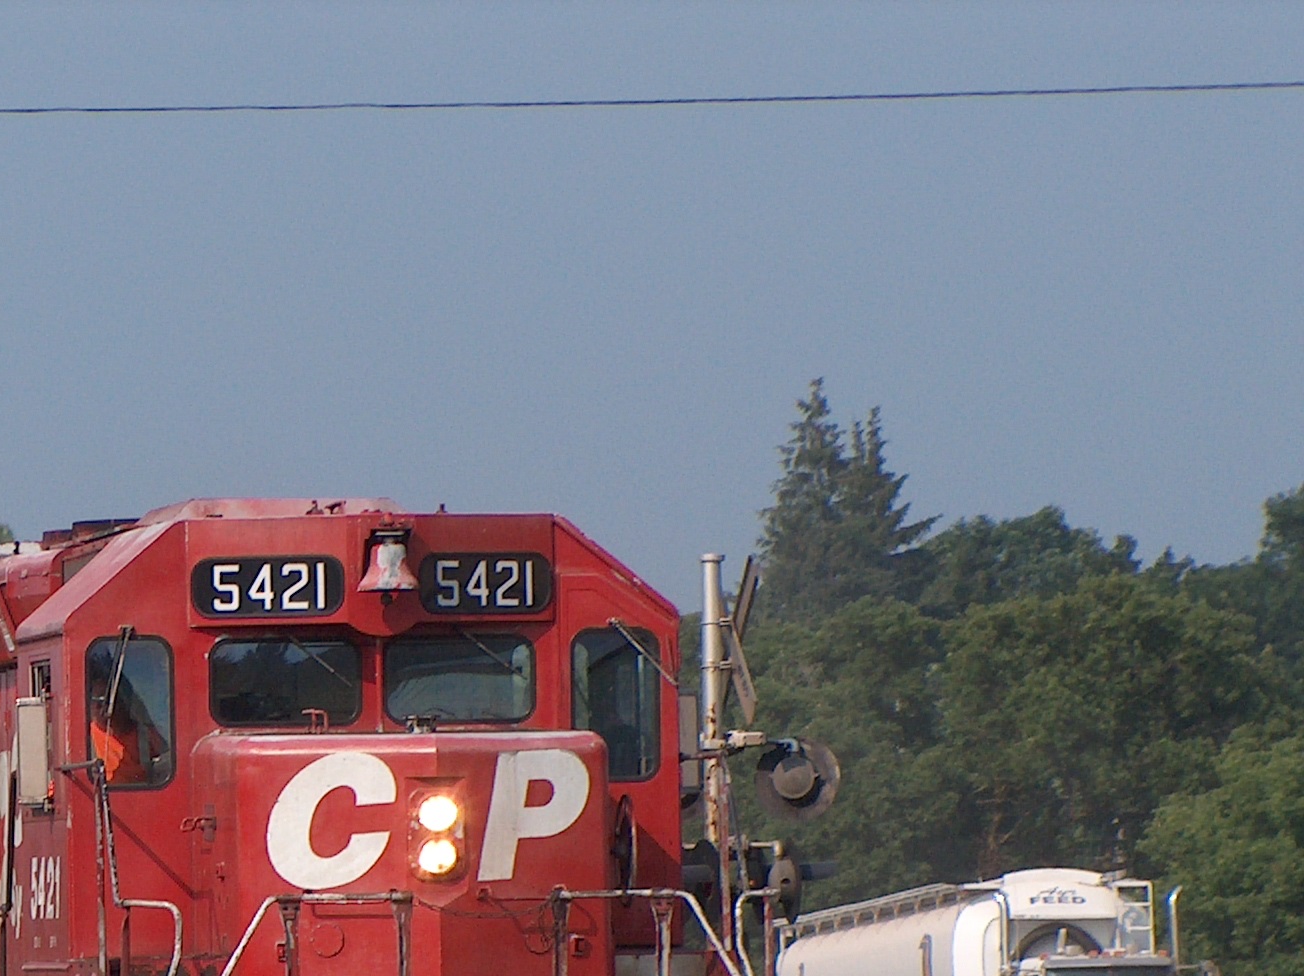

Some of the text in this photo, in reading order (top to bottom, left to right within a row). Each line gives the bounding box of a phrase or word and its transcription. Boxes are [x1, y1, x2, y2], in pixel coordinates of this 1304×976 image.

[212, 562, 326, 612] 5421
[435, 560, 533, 607] 5421
[30, 855, 62, 920] 5421
